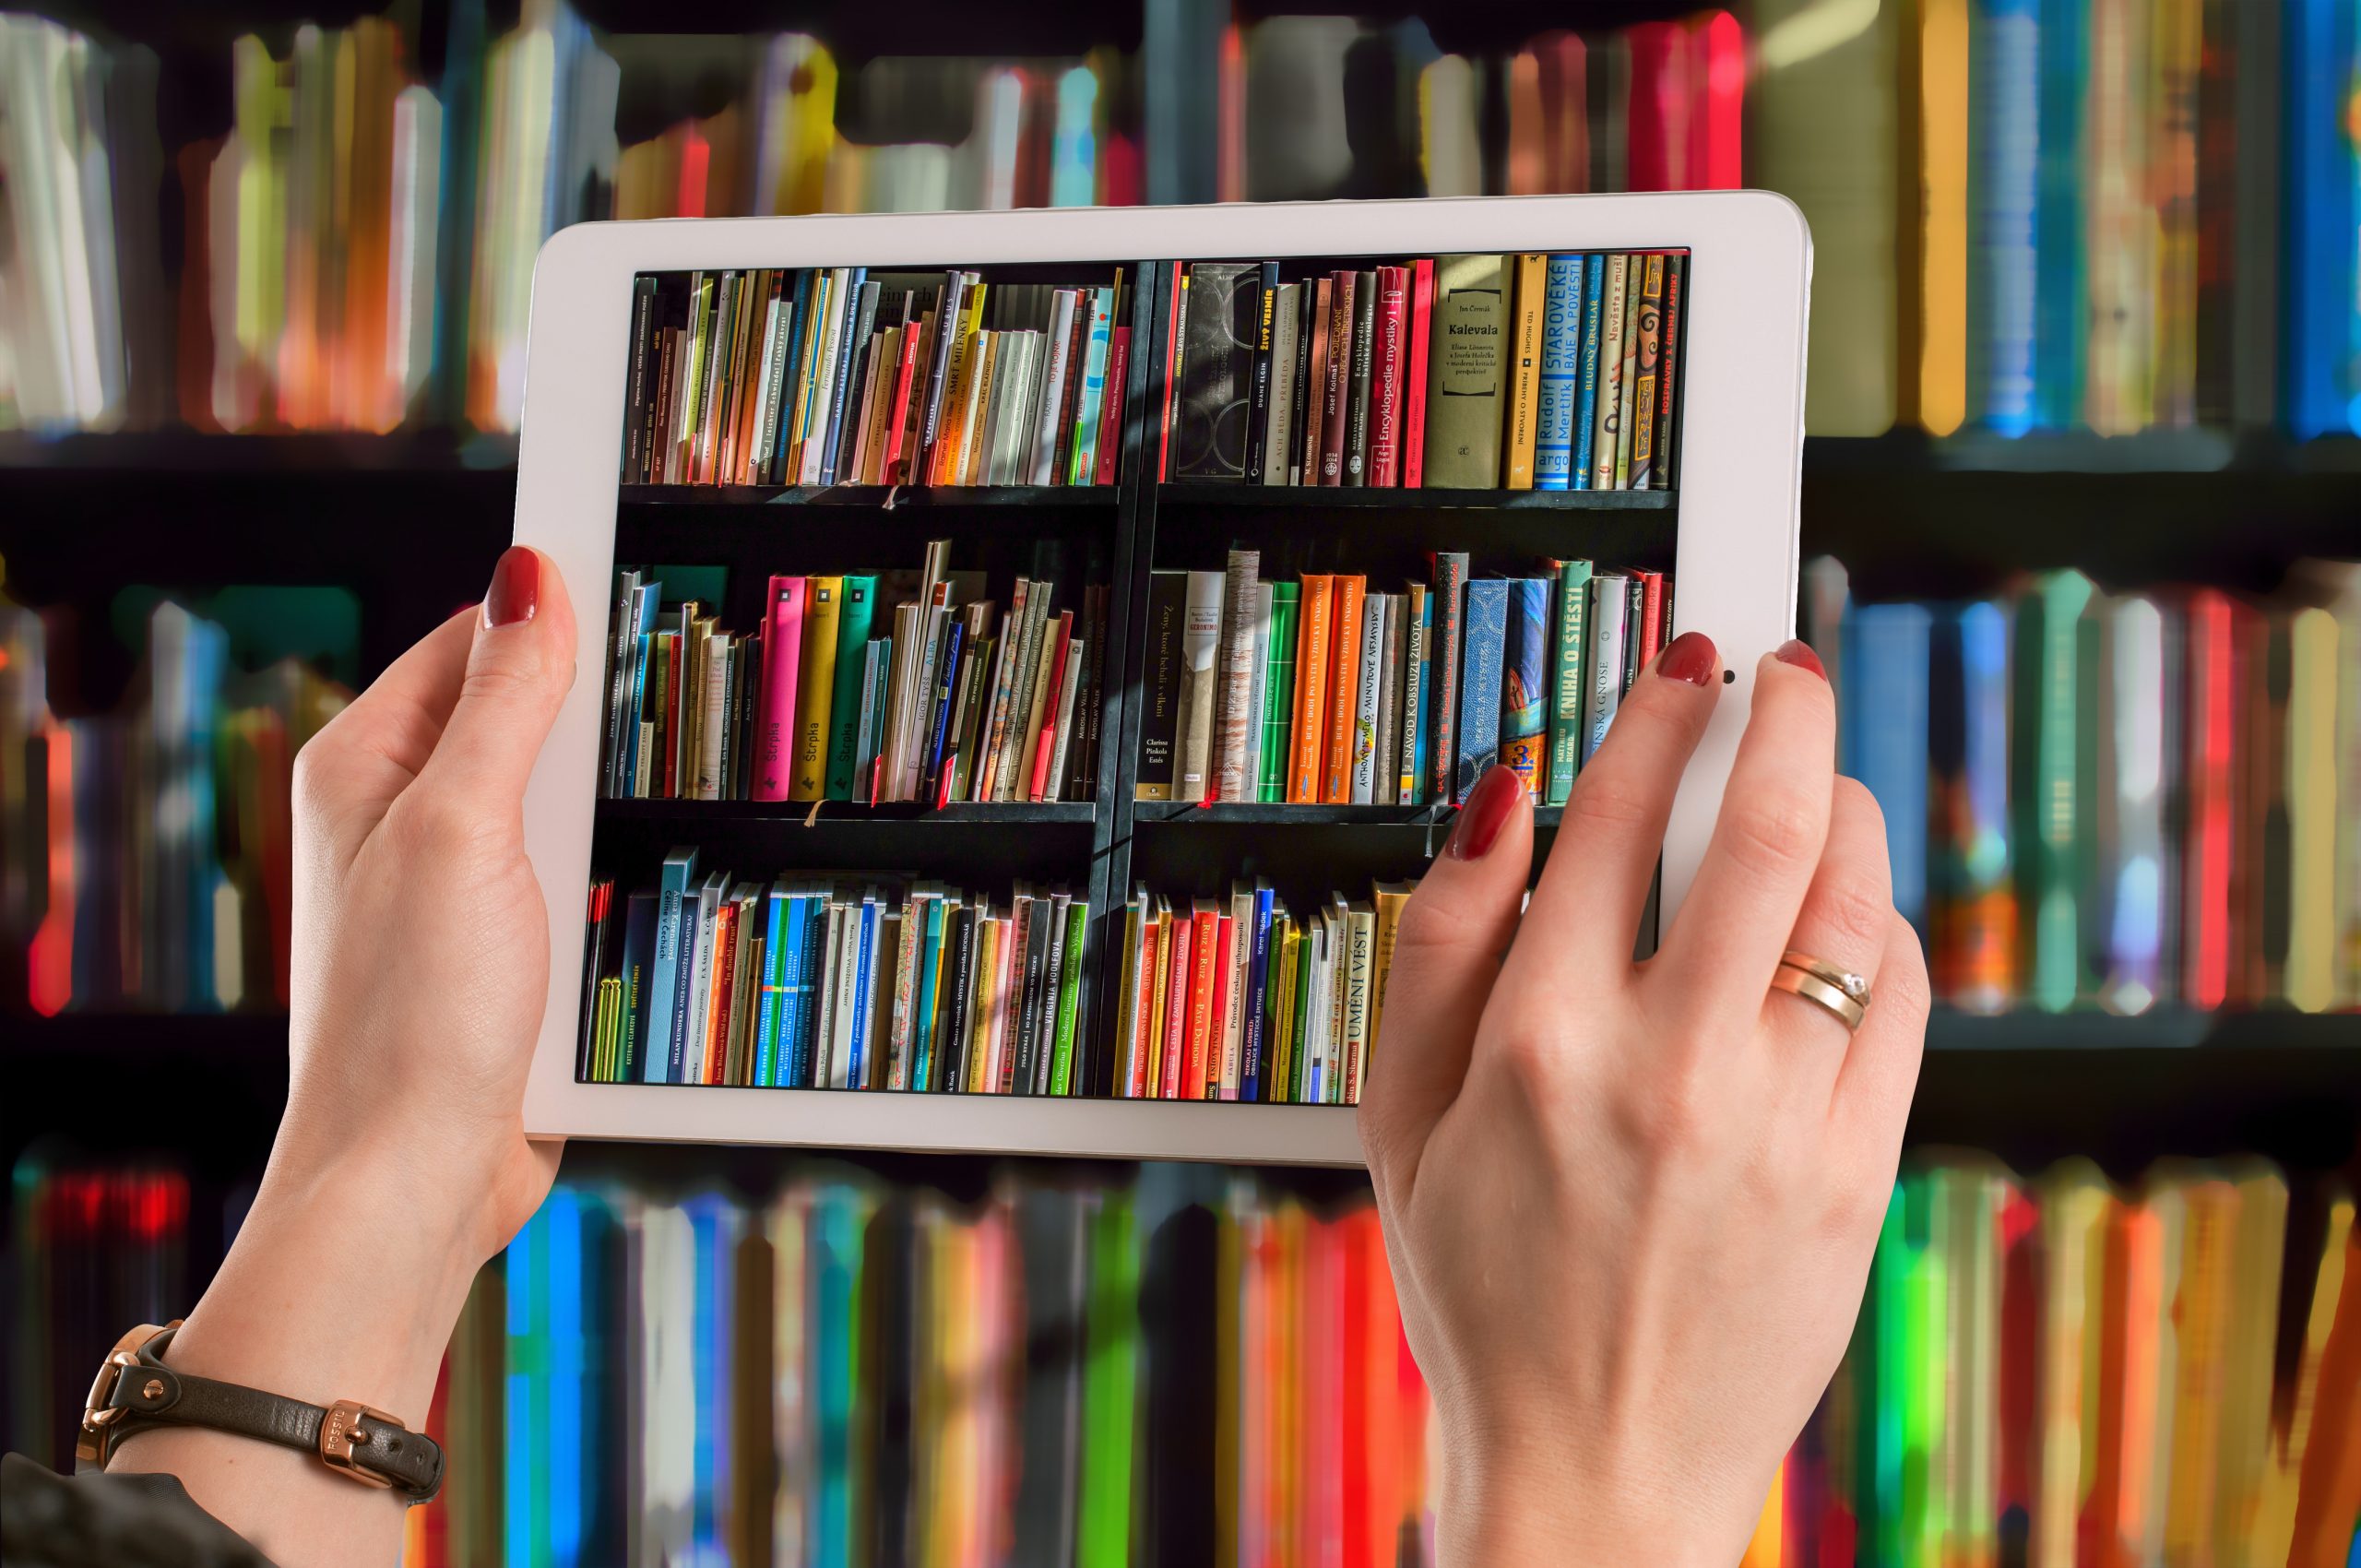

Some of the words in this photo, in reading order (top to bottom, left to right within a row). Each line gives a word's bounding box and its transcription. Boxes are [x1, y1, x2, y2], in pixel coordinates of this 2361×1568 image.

[1262, 290, 1274, 325] VESMÍR
[1546, 265, 1567, 368] STAROVĚKÉ
[1608, 296, 1620, 340] Nevěsta
[826, 329, 836, 353] Pessoa
[954, 318, 968, 363] MILENKY
[1383, 317, 1398, 362] mystiky
[1448, 325, 1498, 335] Kalevala
[1567, 324, 1575, 333] A
[1563, 339, 1576, 368] BÁJE
[822, 355, 834, 389] Fernando
[1329, 364, 1339, 392] Kolmaš
[1328, 395, 1336, 415] Josef
[1379, 364, 1395, 441] Encyklopedie
[1539, 384, 1555, 438] Rudolf
[1557, 384, 1572, 438] Mertlík
[1562, 588, 1583, 643] ŠTĚSTÍ
[1408, 619, 1420, 658] ŽIVOTA
[1563, 650, 1578, 661] O
[918, 699, 927, 720] IGOR
[925, 640, 936, 665] ALBA
[1406, 660, 1418, 706] OBSLUZE
[1559, 669, 1578, 719] KNIHA
[1596, 661, 1608, 704] GNOSE
[1078, 709, 1086, 739] MIROSLAV
[1403, 719, 1415, 757] NÁVOD
[1565, 736, 1574, 762] RICARD
[663, 890, 671, 915] Céline
[668, 914, 679, 960] Kareninová
[1258, 910, 1267, 934] Sládek
[659, 925, 670, 959] Čechách
[1256, 936, 1264, 955] Karel
[1351, 927, 1367, 971] VÉST
[724, 945, 735, 974] double
[956, 978, 965, 1001] MYSTIK
[1044, 986, 1055, 1024] VIRGINIA
[1229, 997, 1240, 1028] Průvodce
[1347, 977, 1364, 1038] UMĚNÍ
[675, 1009, 684, 1041] KUNDERA
[1061, 1014, 1071, 1041] Moderní
[1348, 1045, 1358, 1075] Sharma
[1347, 1086, 1355, 1104] obin
[327, 1410, 346, 1451] FOSSIL
